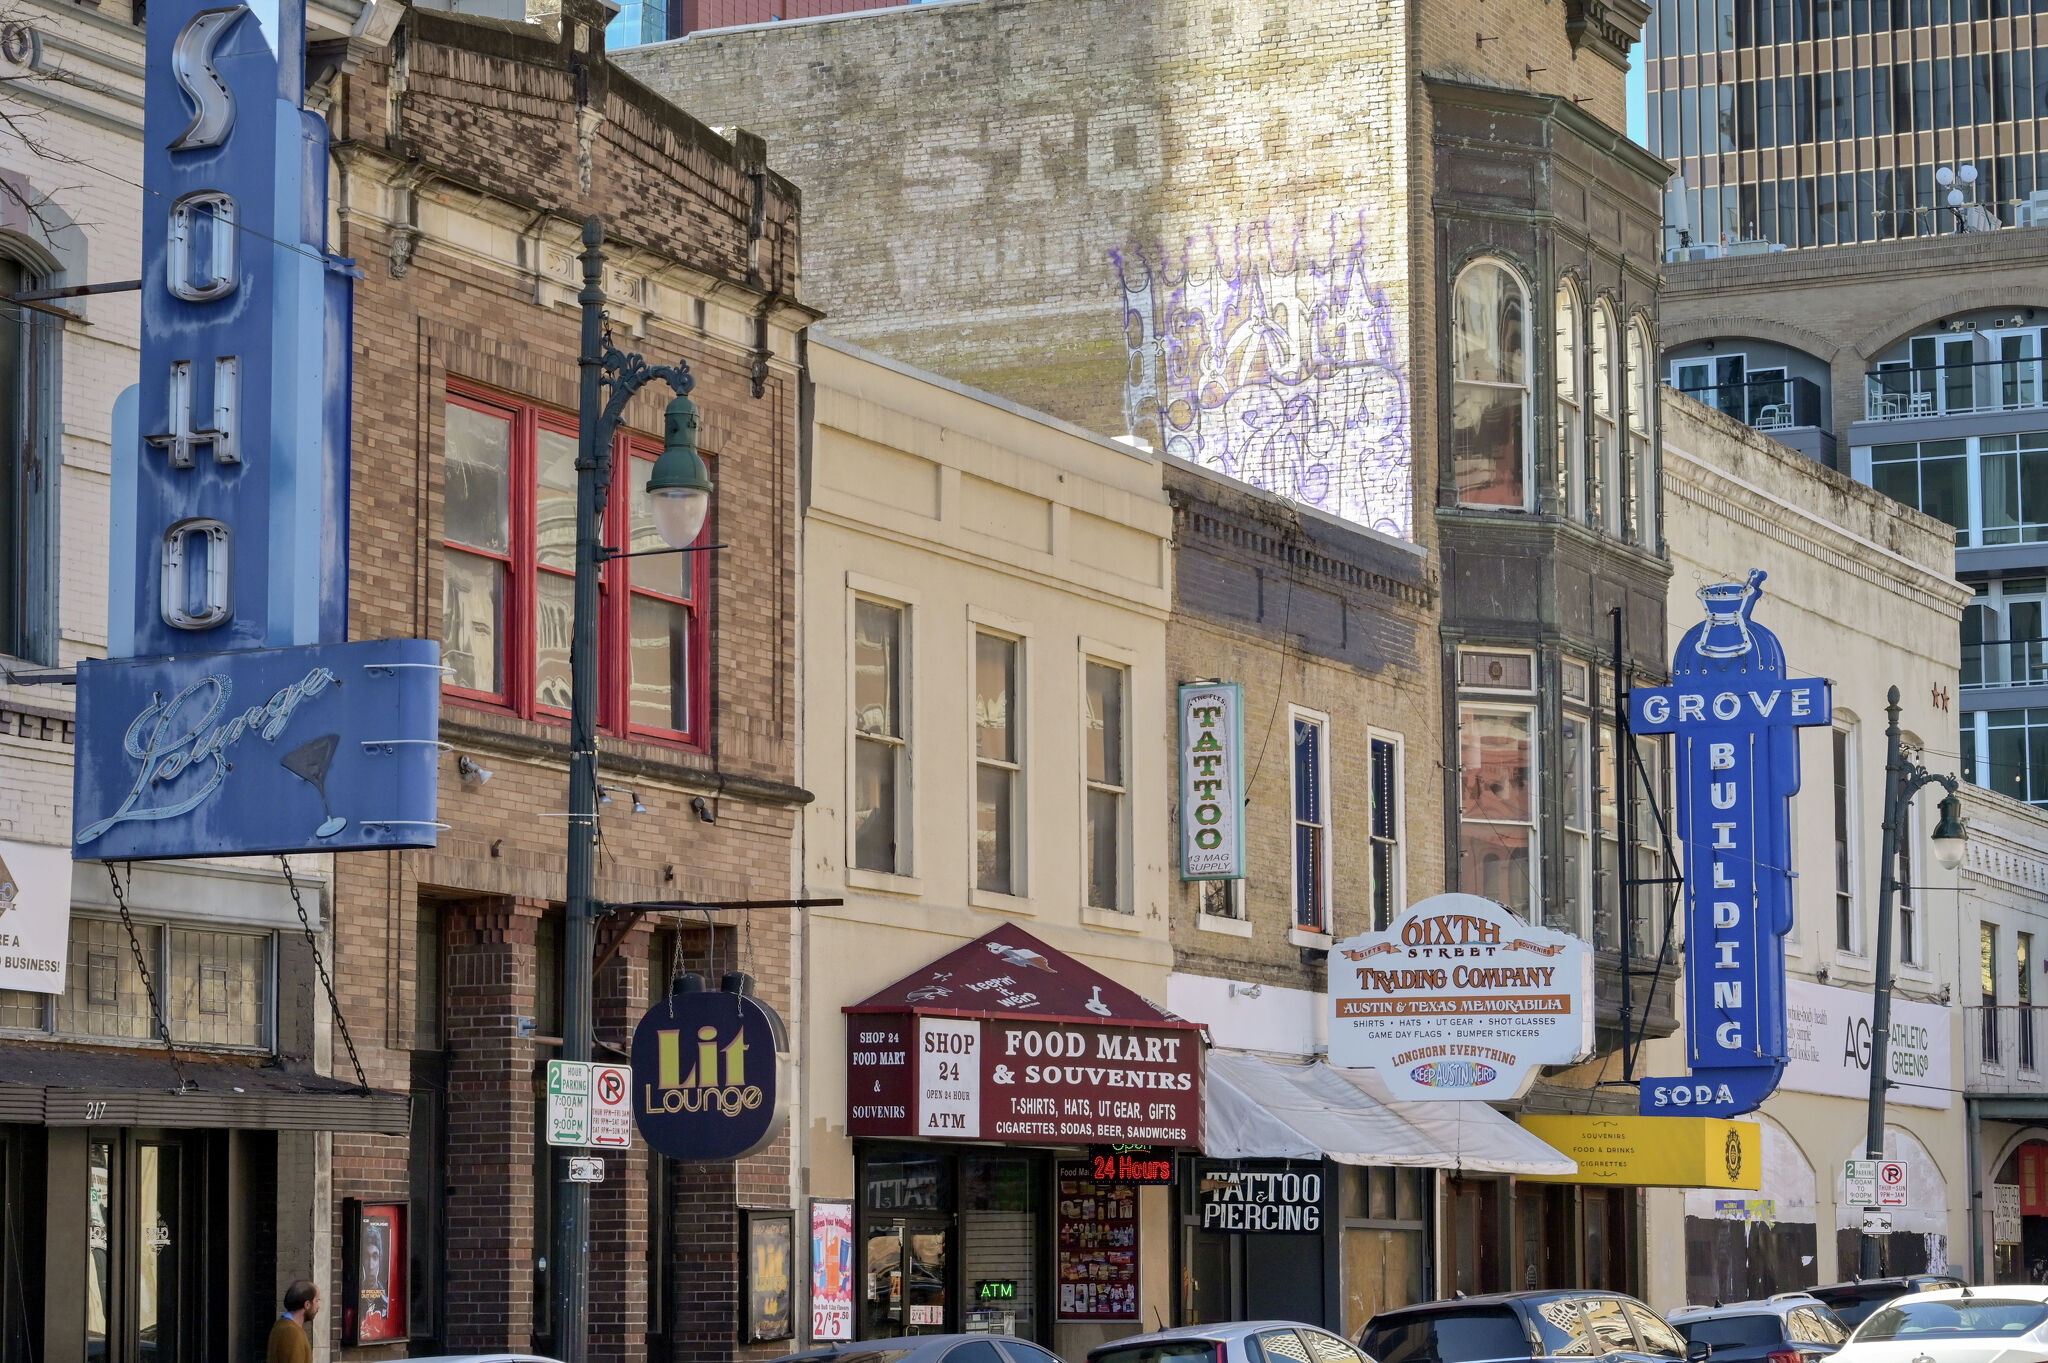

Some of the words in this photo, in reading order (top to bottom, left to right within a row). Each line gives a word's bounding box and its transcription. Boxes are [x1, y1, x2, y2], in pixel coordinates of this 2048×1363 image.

[143, 4, 249, 629] SOHO
[1209, 694, 1225, 705] FLES
[1643, 688, 1810, 723] GROVE
[76, 667, 334, 844] Lounge
[1192, 706, 1222, 849] TATTOO
[1203, 854, 1229, 862] MAG
[1190, 863, 1230, 872] SUPPLY
[1710, 742, 1742, 1049] BUILDING
[1401, 914, 1501, 946] 6IXTH
[12, 935, 20, 947] A
[1519, 941, 1550, 954] SOUVENIRS
[1359, 946, 1381, 958] GIFTS
[1408, 946, 1496, 959] STREET
[5, 956, 60, 972] BUSINESS!
[1344, 1001, 1392, 1014] AUSTIN
[1397, 1001, 1406, 1012] &
[1409, 1000, 1457, 1012] TEXAS
[1460, 999, 1563, 1013] MEMORABILIA
[1354, 1020, 1384, 1028] SHIRTS
[860, 1032, 884, 1043] SHOP
[888, 1033, 899, 1042] 24
[1414, 1030, 1441, 1038] FLAGS
[1496, 1029, 1539, 1037] STICKERS
[1891, 1024, 1928, 1050] ATHLETIC
[925, 1032, 974, 1054] SHOP
[1005, 1030, 1086, 1057] FOOD
[1096, 1034, 1180, 1063] MART
[657, 1025, 749, 1089] Lit
[853, 1052, 877, 1065] FOOD
[880, 1052, 905, 1065] MART
[1392, 1045, 1446, 1066] LONGHORN
[1450, 1044, 1516, 1065] EVERYTHING
[551, 1067, 560, 1088] 2
[568, 1067, 582, 1076] HOUR
[939, 1062, 959, 1080] 24
[993, 1064, 1015, 1084] &
[1026, 1066, 1192, 1090] SOUVENIRS
[1414, 1064, 1435, 1082] KEEP
[1436, 1064, 1470, 1086] AUSTIN
[1471, 1065, 1495, 1085] WEIRD
[563, 1079, 586, 1090] PARKING
[874, 1080, 880, 1092] &
[554, 1095, 583, 1107] 7:00AM
[646, 1084, 762, 1117] Lounge
[927, 1090, 942, 1099] OPEN
[945, 1091, 951, 1099] 24
[953, 1091, 970, 1100] HOUR
[1654, 1084, 1734, 1107] SODA
[85, 1102, 107, 1120] 217
[564, 1108, 574, 1118] TO
[853, 1106, 905, 1119] SOUVENIRS
[1011, 1097, 1058, 1118] T-SHIRTS,
[1064, 1098, 1093, 1119] HATS,
[1099, 1100, 1112, 1117] UT
[1114, 1102, 1143, 1121] GEAR,
[1149, 1103, 1176, 1120] GIFTS
[554, 1119, 583, 1130] 9:00PM
[928, 1113, 966, 1128] ATM
[996, 1121, 1058, 1136] CIGARETTES,
[1060, 1123, 1095, 1137] SODAS,
[1098, 1124, 1125, 1139] BEER,
[1127, 1126, 1186, 1140] SANDWICHES
[1060, 1168, 1077, 1176] Food
[1094, 1156, 1115, 1179] 24
[1120, 1156, 1170, 1179] Hours
[1847, 1164, 1853, 1175] 2
[1206, 1172, 1320, 1202] TATTOO
[1256, 1191, 1268, 1203] &
[1204, 1204, 1319, 1231] PIERCING
[757, 1244, 784, 1277] Lit
[981, 1284, 1012, 1297] ATM
